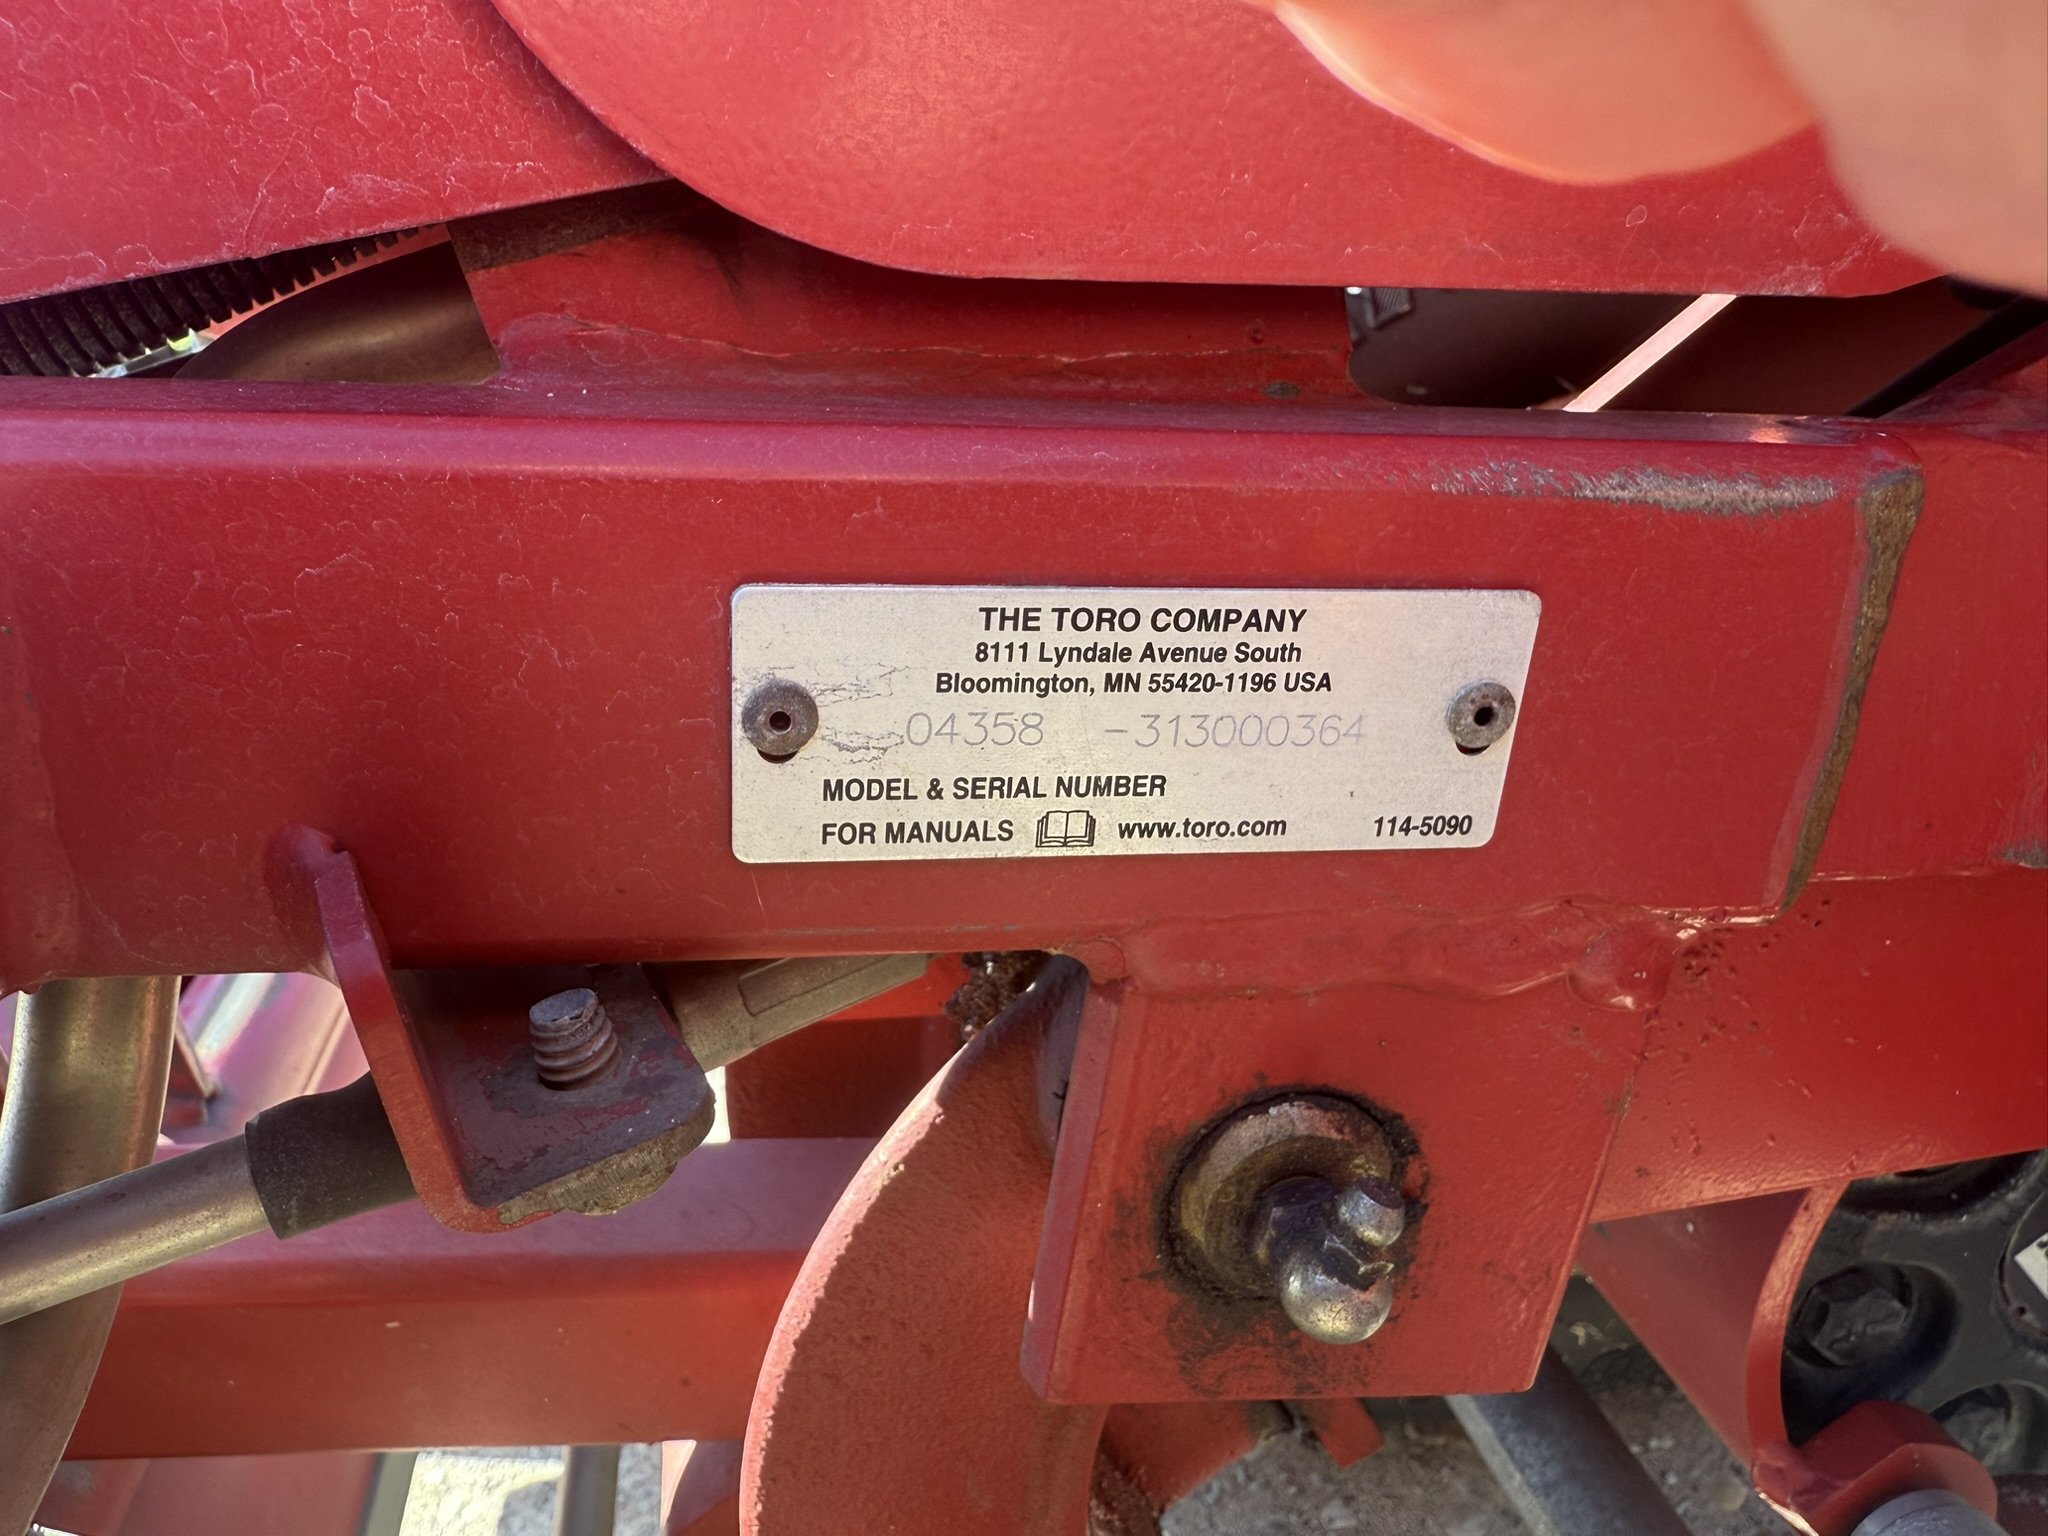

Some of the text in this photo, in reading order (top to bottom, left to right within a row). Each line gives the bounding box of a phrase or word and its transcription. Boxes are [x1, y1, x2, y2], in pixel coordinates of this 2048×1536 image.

[979, 608, 1307, 632] THE TORO COMPANY
[976, 642, 1301, 667] 8111 Lyndale Avenue South
[936, 672, 1331, 698] Bloomington, MN 55420-1196 USA
[905, 711, 1367, 748] 04358 -313000364
[824, 775, 1166, 801] MODEL & SERIAL NUMBER
[822, 820, 1013, 844] FOR MANUALS
[1119, 818, 1286, 838] www.toro.com
[1375, 815, 1472, 836] 114-5090
